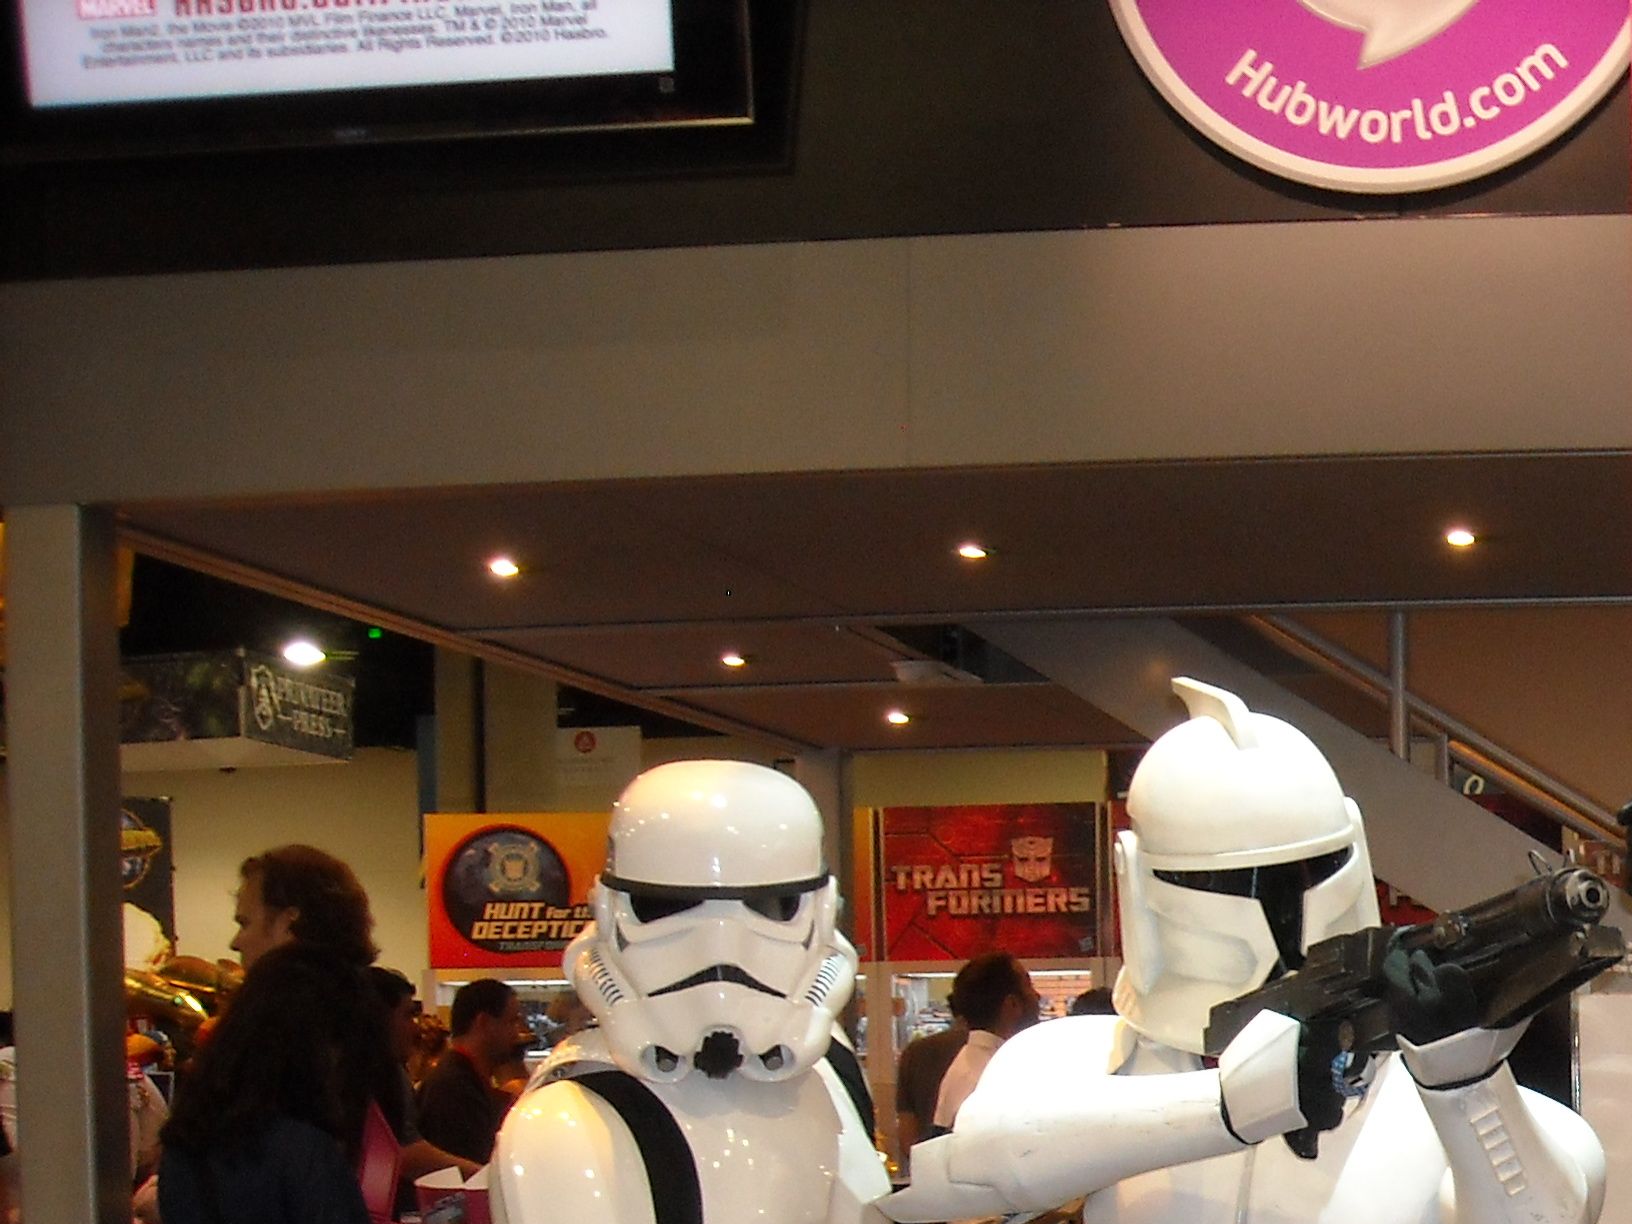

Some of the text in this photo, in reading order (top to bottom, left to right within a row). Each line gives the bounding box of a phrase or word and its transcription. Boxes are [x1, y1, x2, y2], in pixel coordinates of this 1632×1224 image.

[1225, 42, 1570, 144] Hubworld.com
[891, 863, 1003, 890] TRANS
[483, 902, 545, 920] HUNT
[546, 906, 571, 919] for
[927, 887, 1092, 916] FORMERS
[472, 920, 588, 940] DECEPTIC
